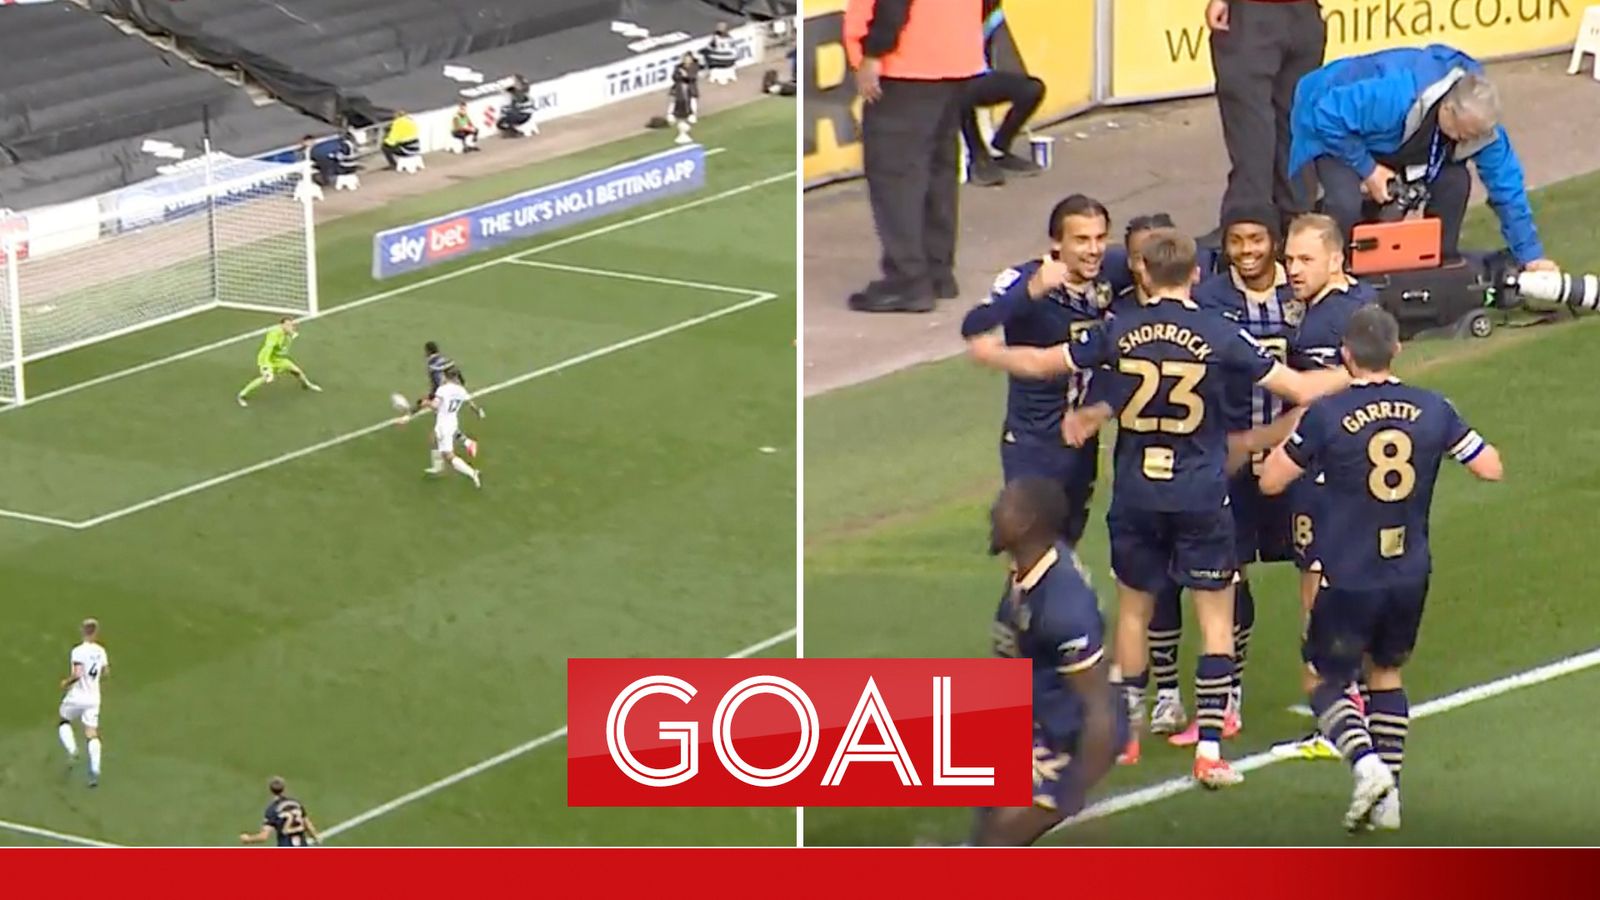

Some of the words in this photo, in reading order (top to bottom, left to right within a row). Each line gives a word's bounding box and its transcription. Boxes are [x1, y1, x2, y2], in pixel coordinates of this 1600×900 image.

[389, 235, 425, 263] sky
[430, 224, 466, 251] bet
[479, 211, 512, 237] THE
[514, 200, 554, 227] UK'S
[555, 187, 594, 216] NO.1
[595, 169, 663, 205] BETTING
[664, 159, 696, 185] APP
[1118, 323, 1213, 361] SHORROCK
[1117, 357, 1207, 435] 23
[1342, 401, 1423, 433] GARRITY
[1366, 428, 1417, 502] 8
[88, 662, 98, 681] 4
[278, 808, 305, 835] 23
